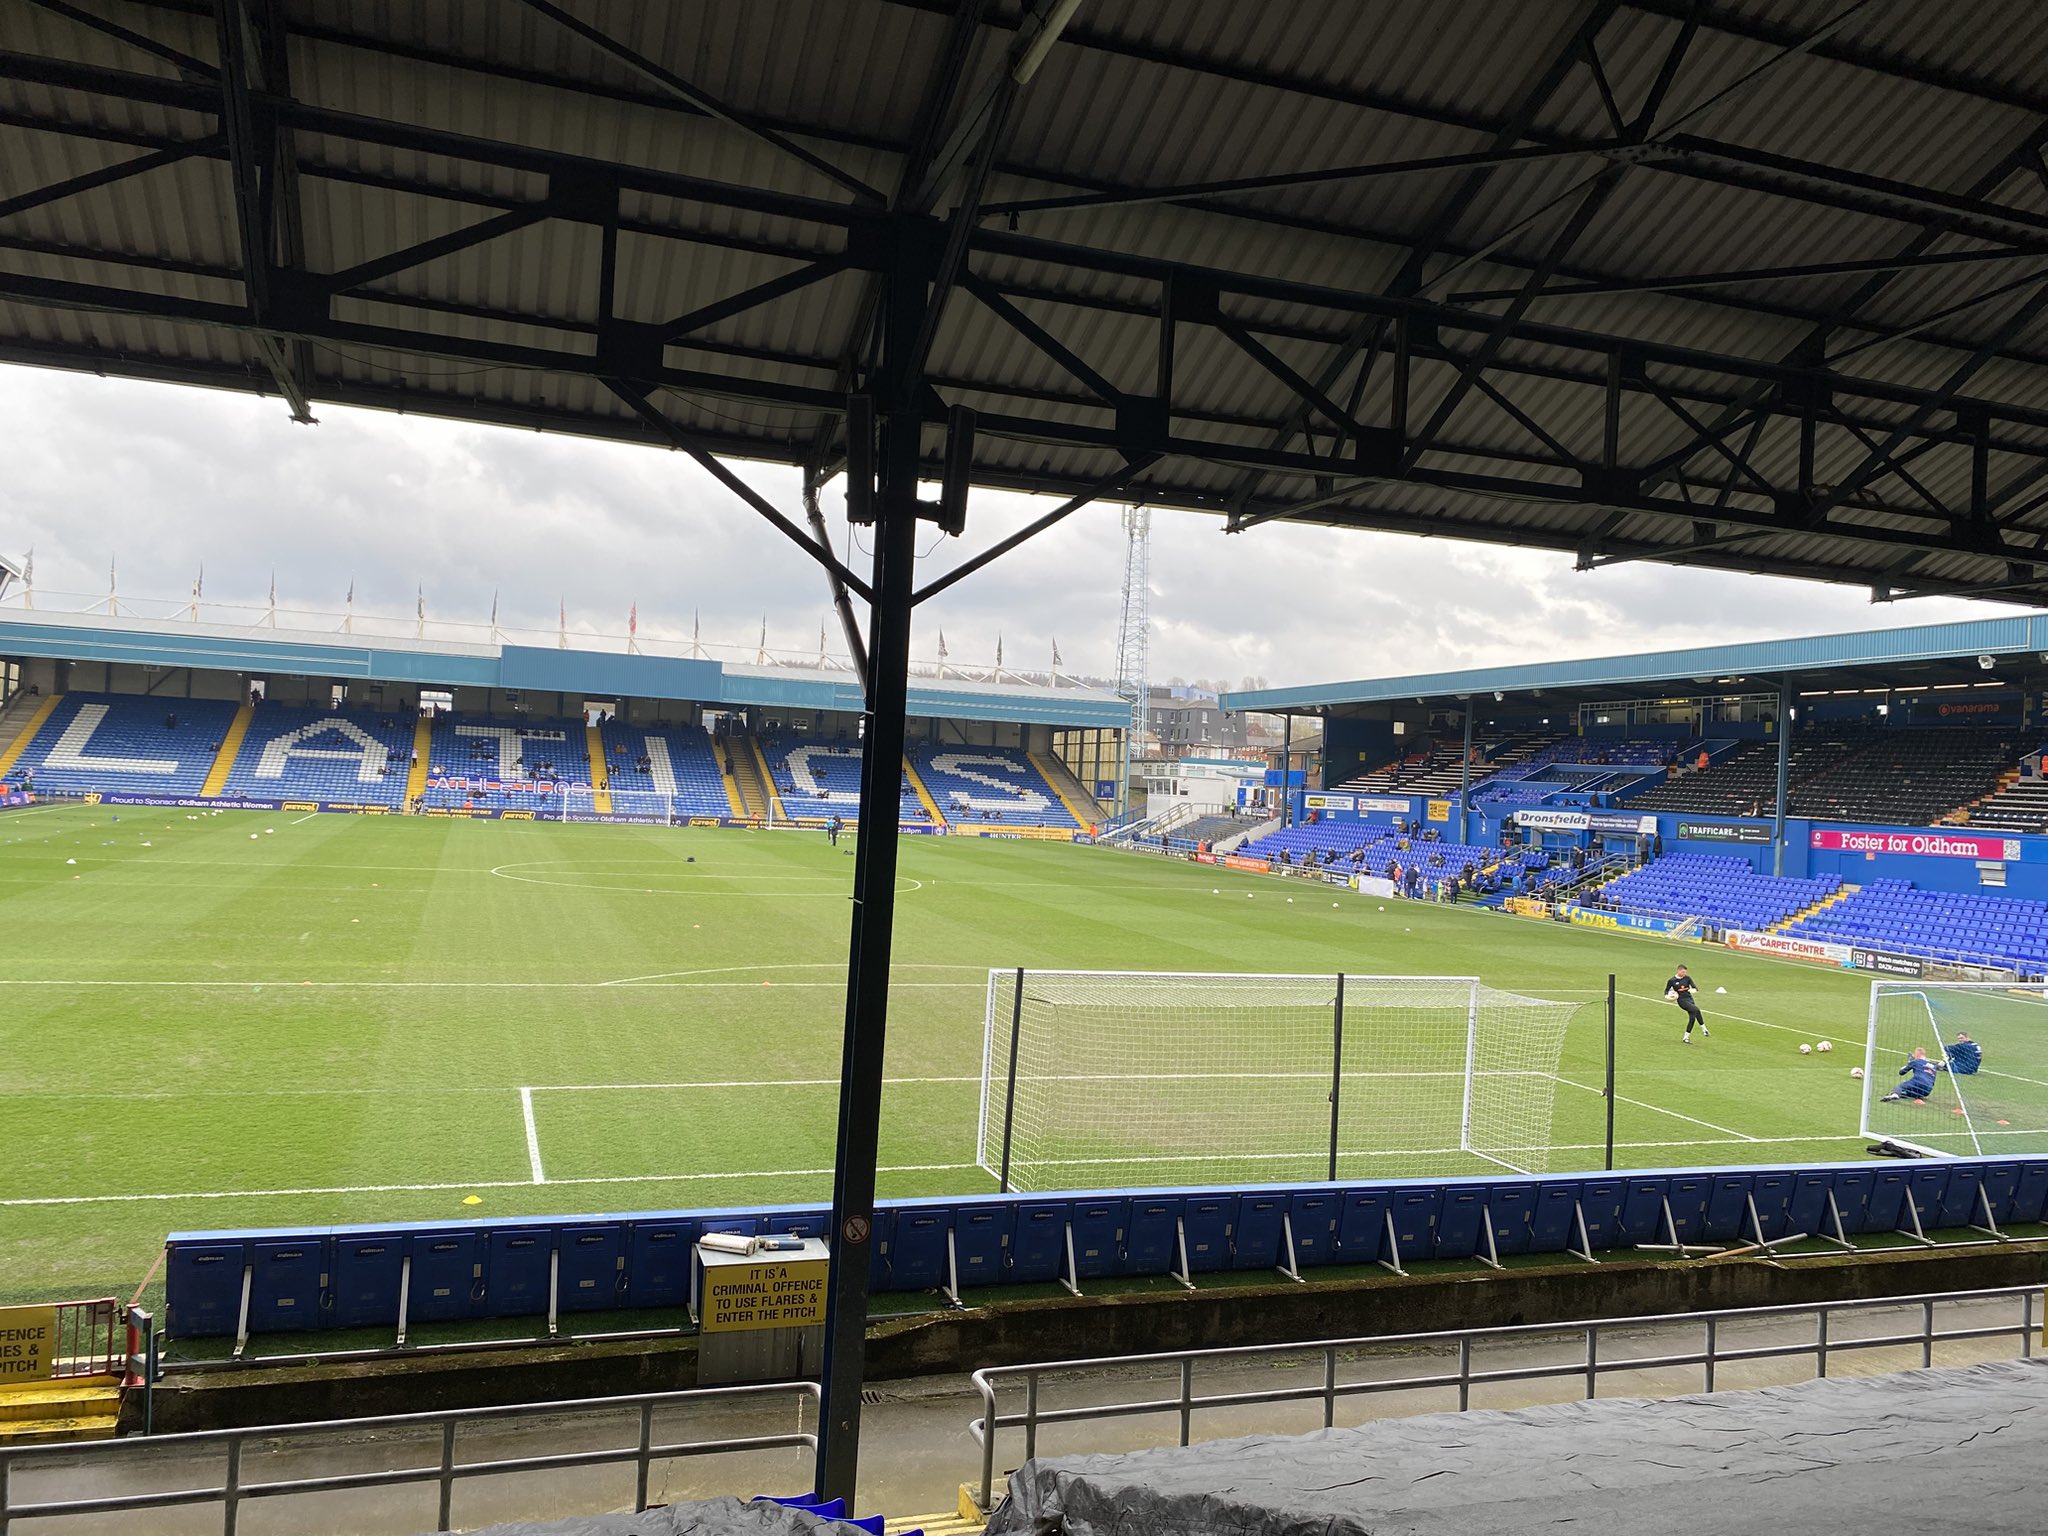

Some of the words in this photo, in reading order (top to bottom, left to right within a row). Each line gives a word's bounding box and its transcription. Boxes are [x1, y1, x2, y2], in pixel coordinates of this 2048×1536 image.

[1951, 704, 1999, 713] vanarama
[111, 797, 134, 805] Proud
[144, 798, 176, 807] Sponsor
[178, 799, 209, 807] Oldham
[210, 800, 241, 808] Athletic
[243, 801, 273, 809] Women
[572, 815, 599, 823] Sponsor
[1520, 813, 1587, 826] Dronsfields
[1689, 826, 1734, 836] TRAFFICARE
[1841, 833, 1883, 850] Foster
[1887, 836, 1908, 851] for
[1912, 836, 1979, 856] Oldham
[1581, 911, 1617, 927] TYRES
[1760, 937, 1791, 950] CARPET
[1791, 941, 1825, 955] CENTRE
[750, 1270, 761, 1280] IT
[765, 1269, 775, 1279] IS
[780, 1268, 787, 1278] A
[713, 1283, 768, 1296] CRIMINAL
[773, 1279, 822, 1292] OFFENCE
[716, 1299, 730, 1309] TO
[735, 1297, 757, 1308] USE
[761, 1294, 805, 1306] FLARES
[809, 1293, 818, 1303] &
[716, 1311, 753, 1323] ENTER
[757, 1310, 778, 1320] THE
[783, 1307, 816, 1318] PITCH
[0, 1345, 22, 1357] ES
[29, 1343, 39, 1355] &
